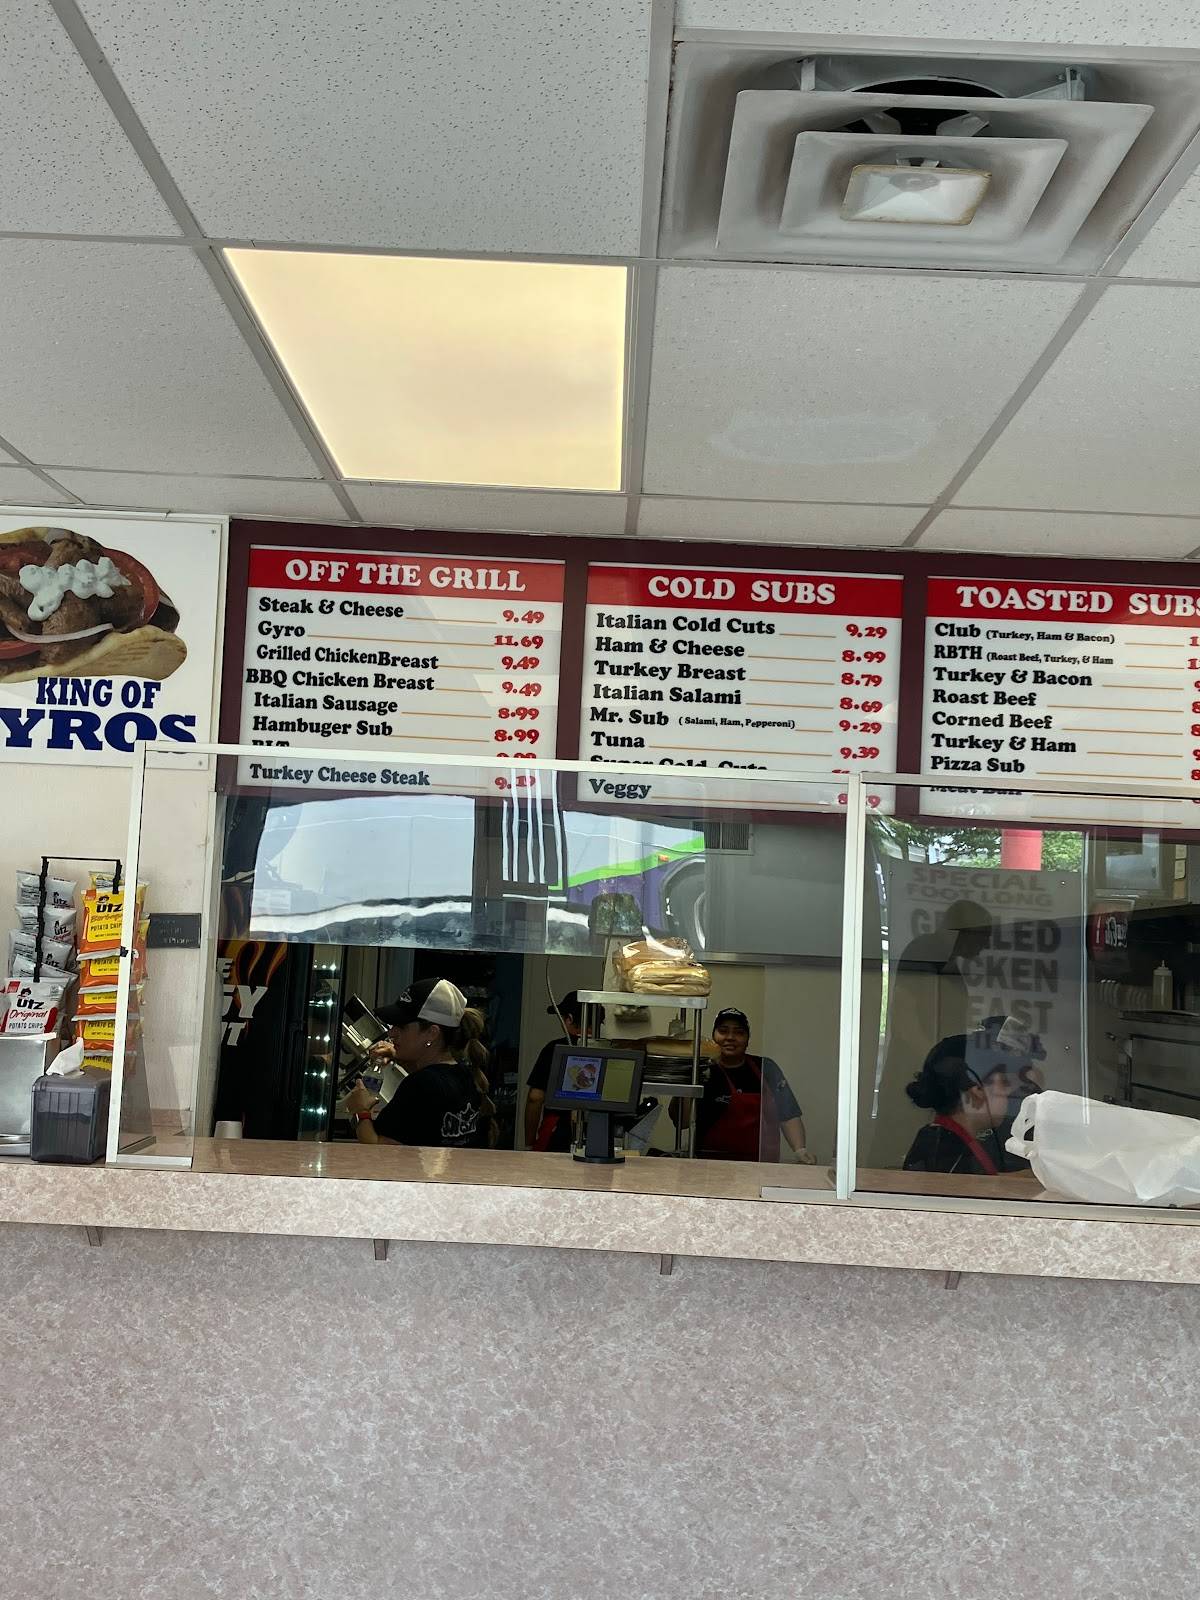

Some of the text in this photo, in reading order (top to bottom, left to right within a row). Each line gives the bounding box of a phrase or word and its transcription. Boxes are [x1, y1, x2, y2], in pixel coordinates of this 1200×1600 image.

[286, 560, 525, 591] OFF THE GRILL
[648, 576, 836, 605] COLD SUBS
[956, 586, 1114, 613] TOASTED
[259, 597, 544, 624] Steak & Cheese 9.49
[258, 621, 544, 649] Gyro 11.69
[597, 613, 886, 638] Italian Cold Cuts 9.29
[935, 623, 981, 637] Club
[986, 630, 1034, 641] (Turkey,
[1037, 632, 1062, 640] Ham
[1077, 633, 1114, 644] Bacon)
[257, 644, 311, 661] Grilled
[502, 656, 540, 669] 9.49
[595, 637, 886, 662] Ham & Cheese 8.99
[934, 645, 983, 659] RBTH
[987, 652, 1017, 662] (Roast
[1019, 653, 1041, 663] Beef,
[1044, 654, 1079, 664] Turkey,
[1093, 656, 1113, 664] Ham
[246, 668, 541, 696] BBQ Chicken Breast 9.49
[594, 660, 882, 687] Turkey Breast 8.79
[933, 667, 1006, 685] Turkey
[1011, 669, 1028, 683] &
[1032, 670, 1092, 686] Bacon
[36, 677, 162, 709] KING OF
[593, 684, 883, 712] Italian Salami 8.69
[933, 689, 989, 704] Roast
[993, 691, 1036, 706] Beef
[254, 692, 539, 720] Italian Sausage 8.99
[253, 716, 539, 743] Hambuger Sub 8.99
[590, 707, 623, 723] Mr.
[629, 709, 669, 725] Sub
[685, 717, 718, 726] Salami,
[720, 718, 743, 727] Ham,
[840, 720, 881, 733] 9.29
[932, 711, 1004, 727] Corned
[1009, 714, 1052, 729] Beef
[591, 731, 879, 758] Tuna 9.39
[931, 733, 1004, 752] Turkey
[1009, 736, 1026, 750] &
[1031, 737, 1076, 752] Ham
[250, 764, 313, 784] Turkey
[318, 767, 376, 783] Cheese
[381, 769, 430, 785] Steak
[931, 756, 982, 771] Pizza
[987, 758, 1025, 773] Sub
[589, 779, 651, 799] Veggy
[912, 867, 1046, 892] SPECIAL
